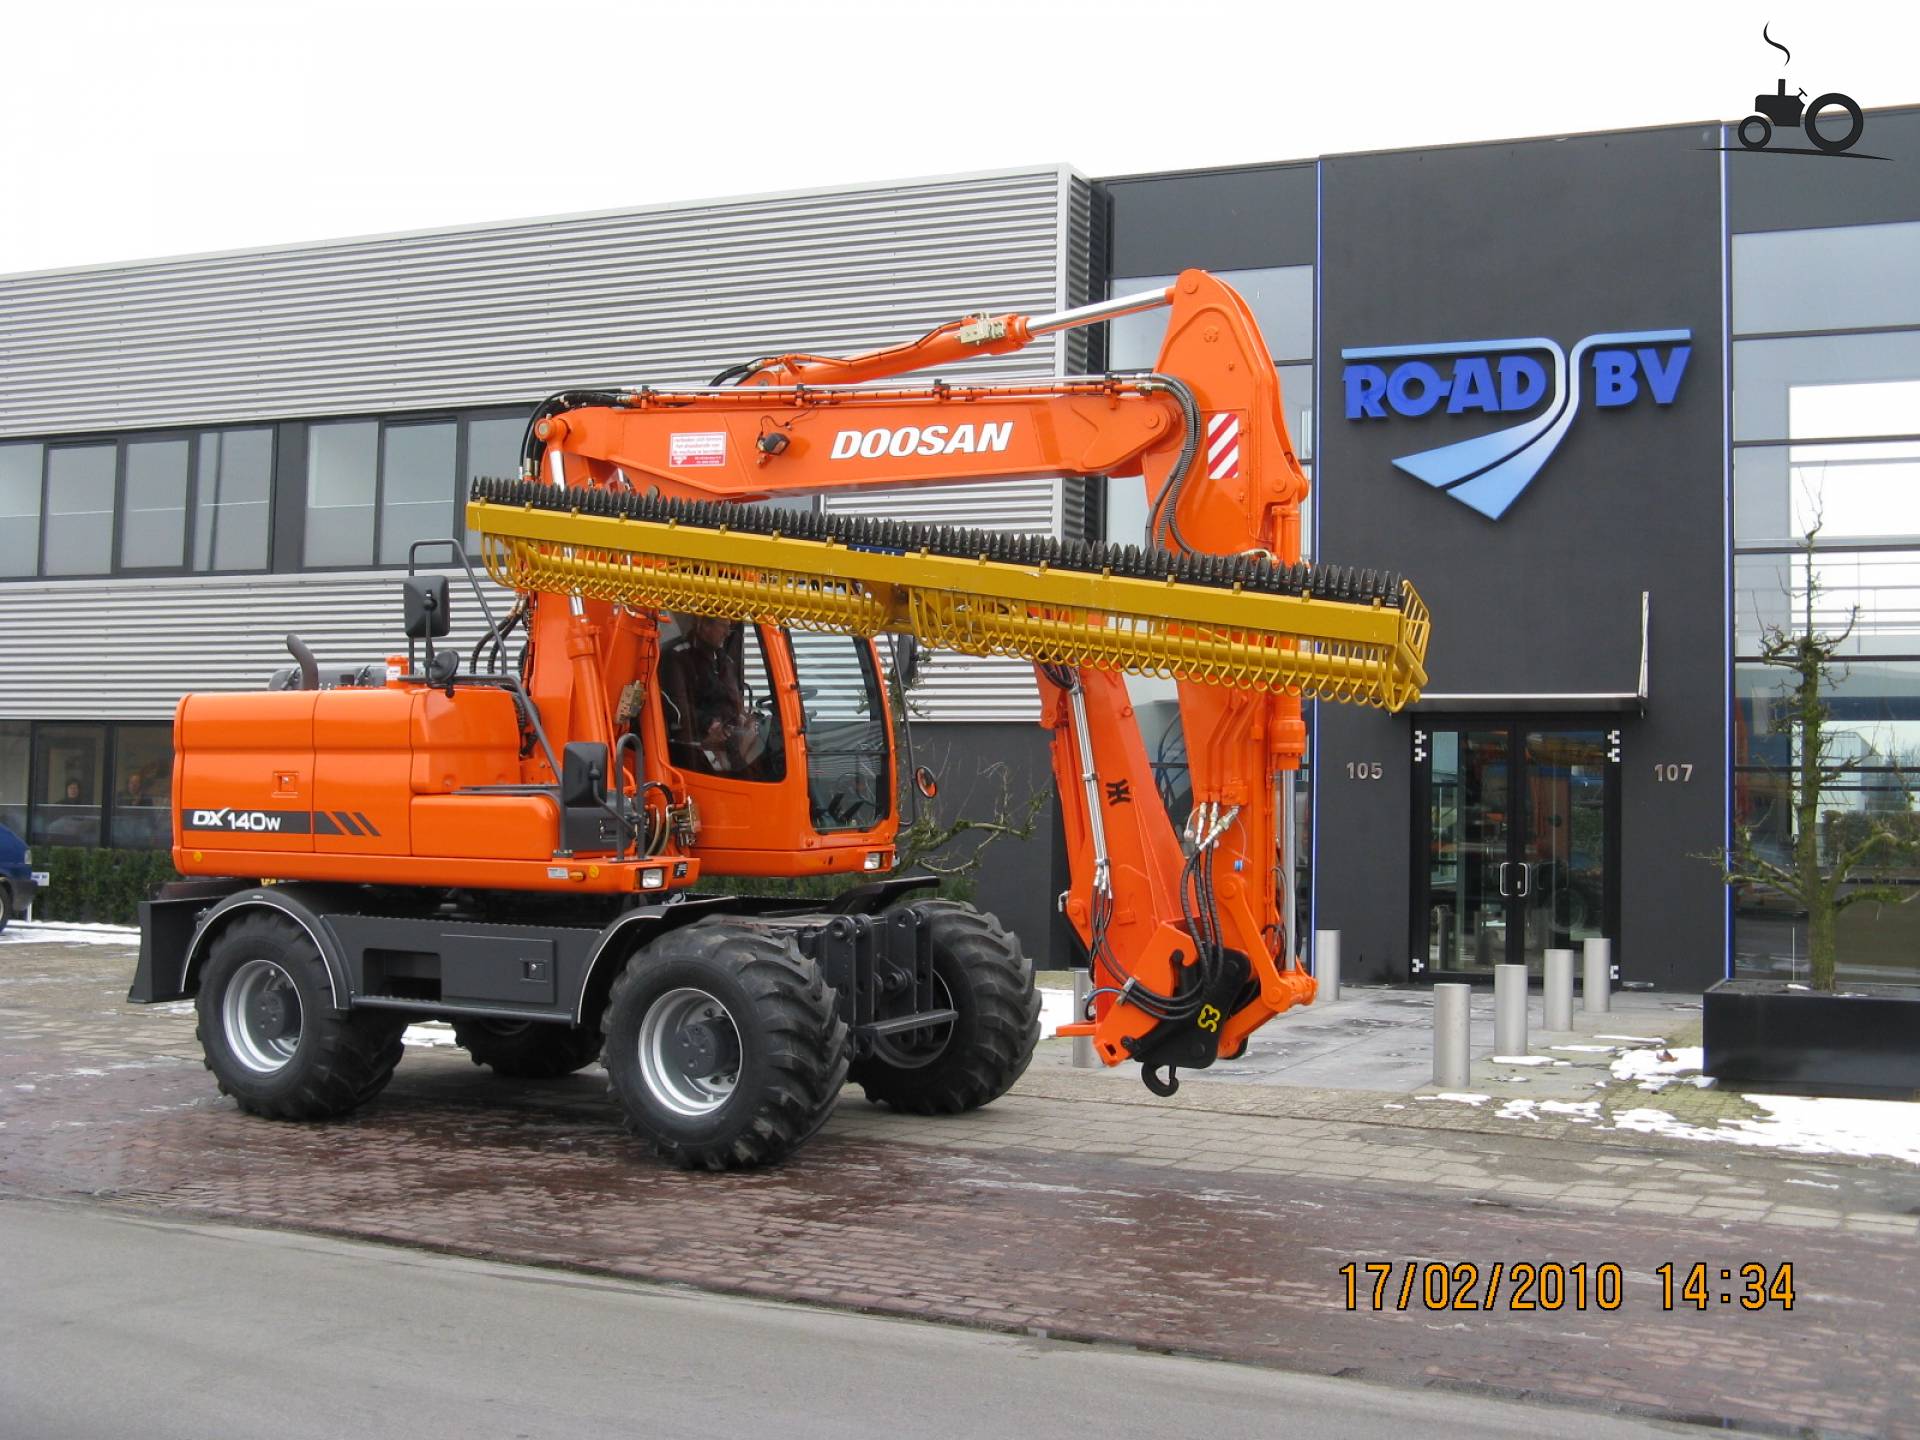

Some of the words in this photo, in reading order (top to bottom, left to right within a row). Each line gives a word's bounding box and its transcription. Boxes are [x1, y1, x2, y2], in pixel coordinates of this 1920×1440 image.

[1592, 346, 1692, 408] BV
[830, 420, 1015, 460] DOOSAN
[1345, 762, 1384, 780] 105
[1654, 763, 1694, 783] 107
